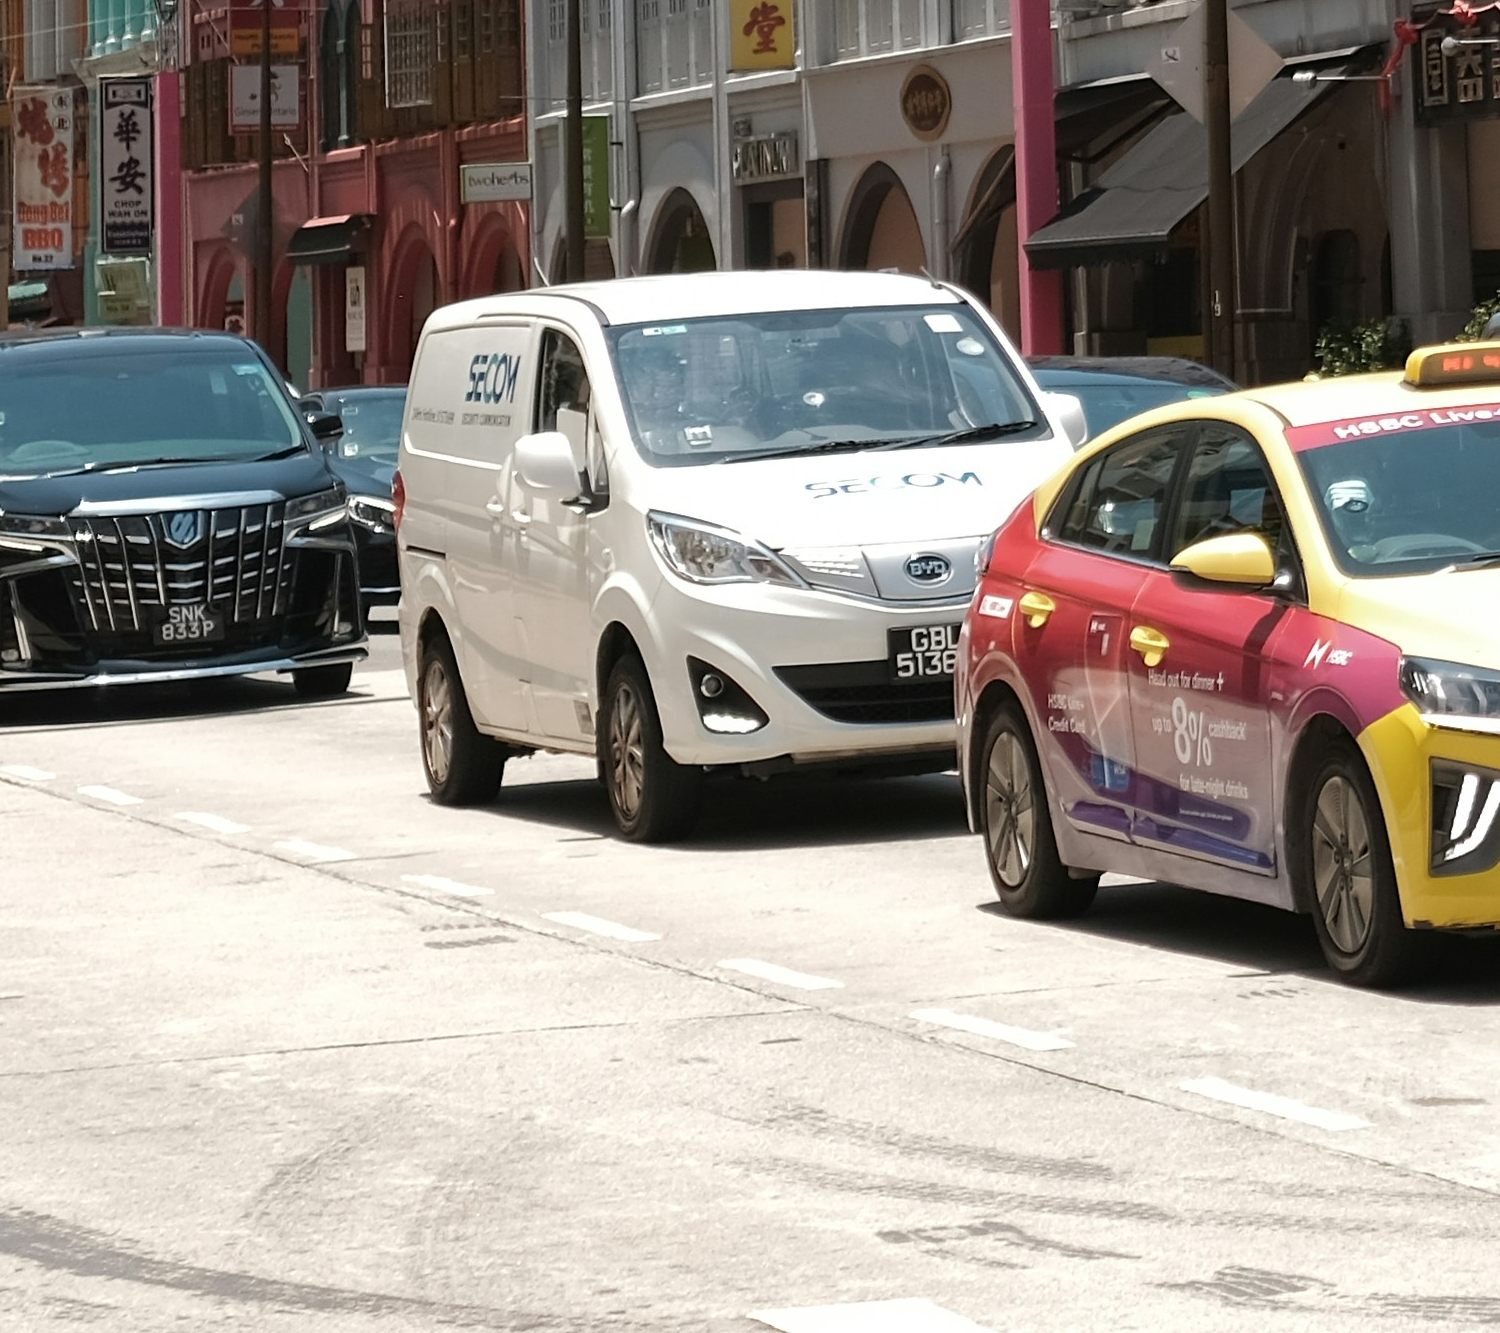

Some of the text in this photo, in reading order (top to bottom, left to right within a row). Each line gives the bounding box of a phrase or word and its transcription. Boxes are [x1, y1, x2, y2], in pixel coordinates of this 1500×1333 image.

[108, 108, 147, 195] 華安
[107, 209, 149, 219] WAH ON
[113, 199, 142, 209] CHOP
[22, 227, 64, 252] BBQ
[464, 352, 522, 405] SECOM
[1333, 414, 1423, 440] HSBC
[804, 471, 983, 500] SECOM
[910, 561, 948, 576] BYD
[168, 603, 206, 624] SNK
[1148, 669, 1167, 686] Head
[1167, 672, 1180, 687] out
[1180, 670, 1192, 689] for
[1192, 673, 1215, 691] dinner
[1047, 694, 1069, 710] HSBC
[1047, 715, 1069, 733] Credit
[1151, 717, 1163, 736] up
[1162, 717, 1172, 733] to
[1171, 696, 1213, 767] 8%
[1179, 773, 1190, 792] for
[1225, 779, 1249, 800] drinks
